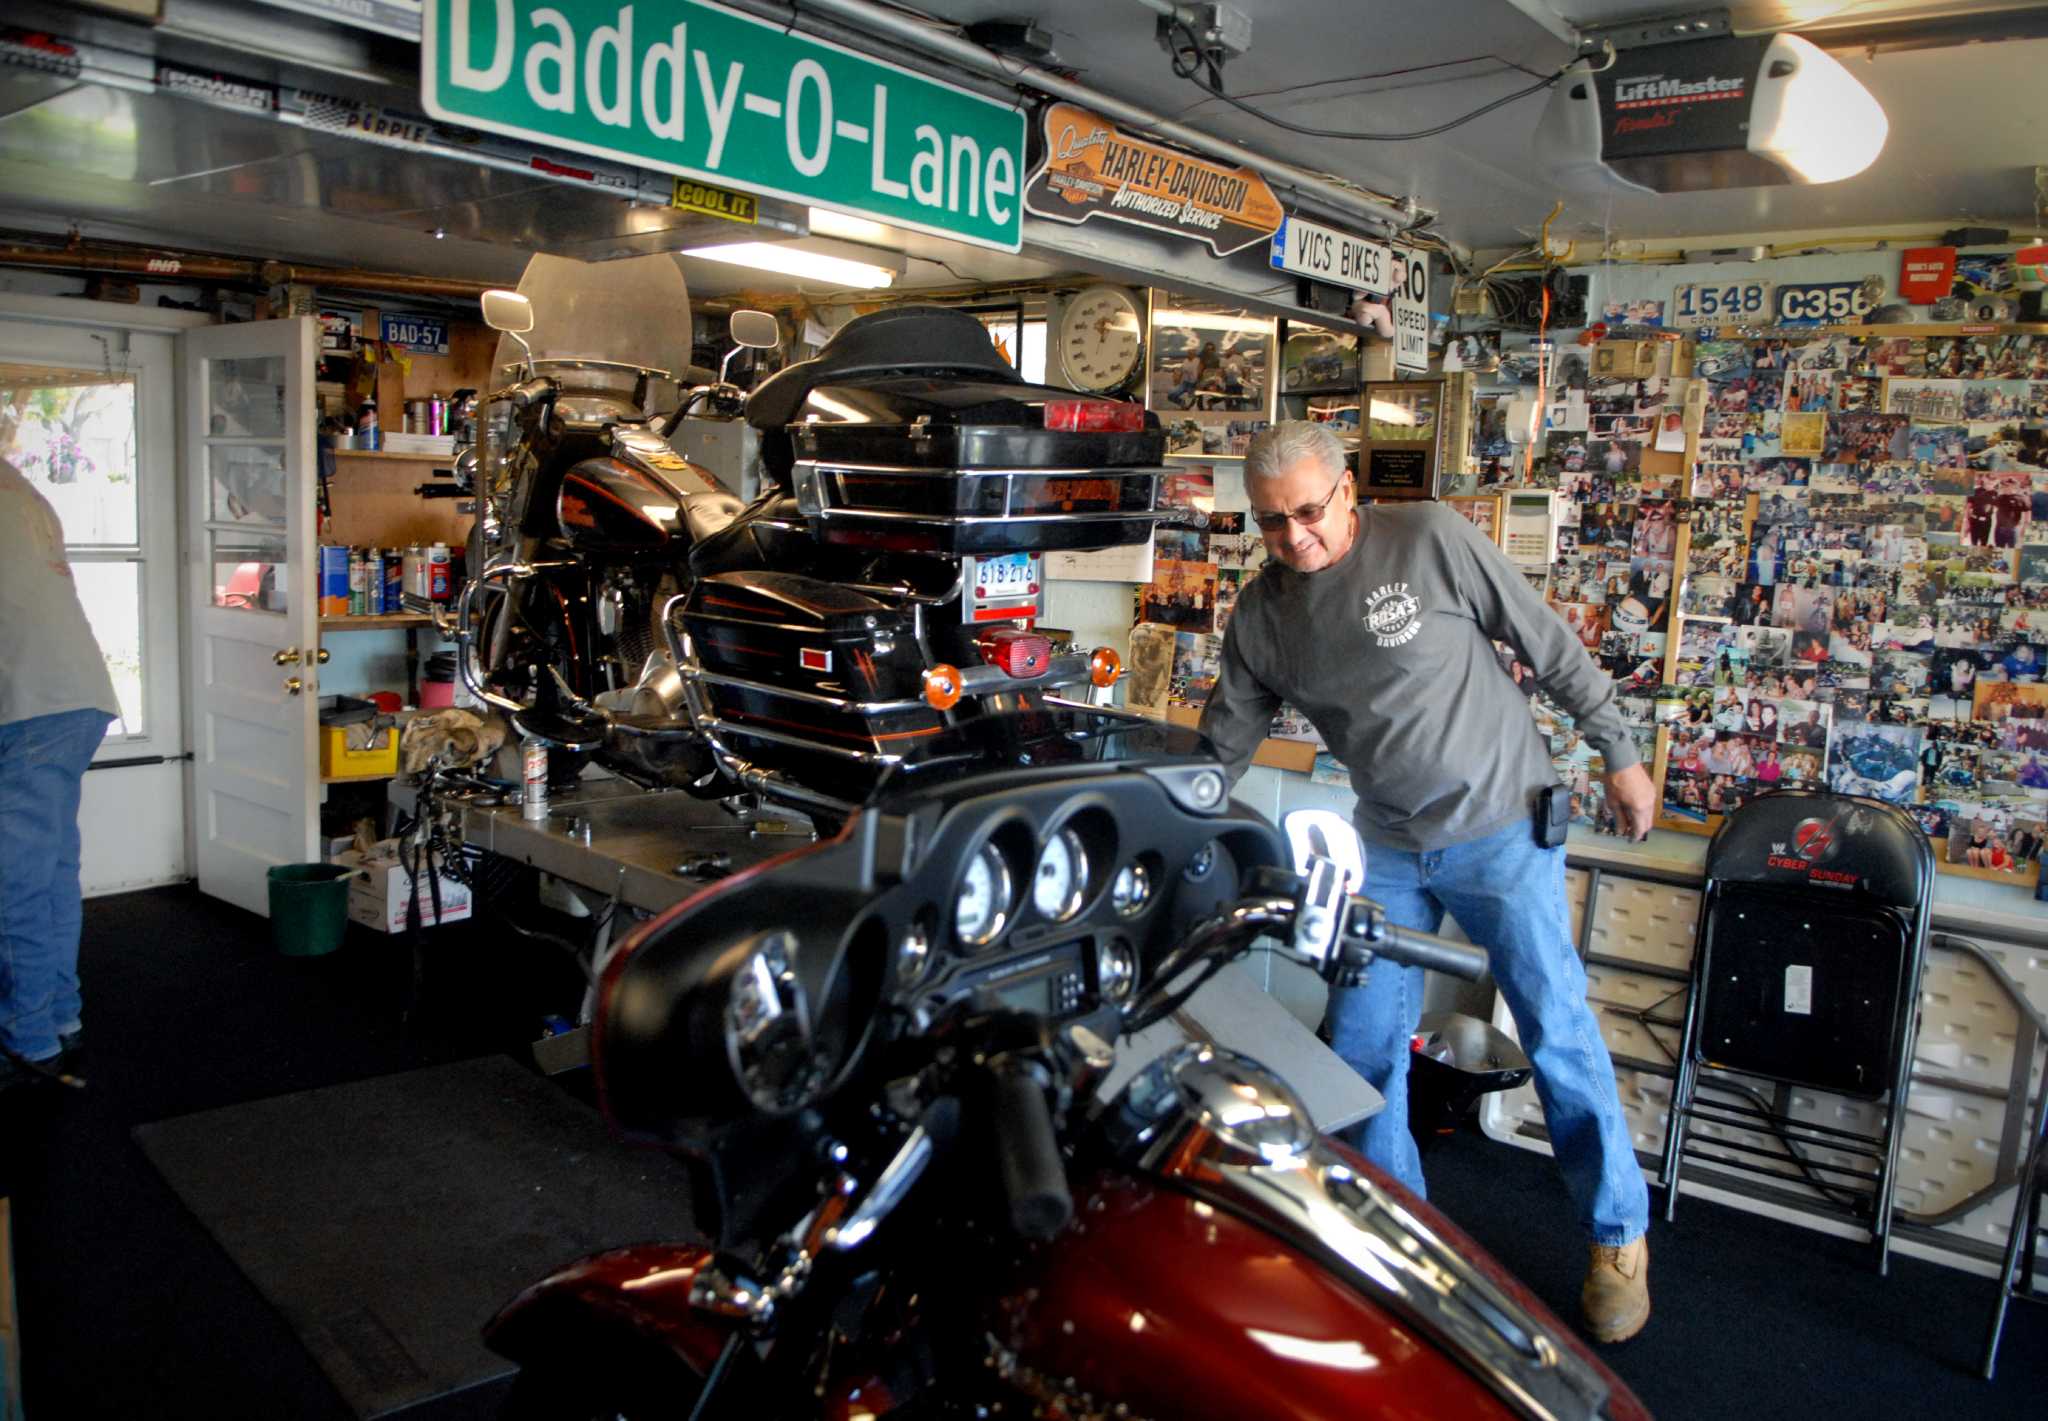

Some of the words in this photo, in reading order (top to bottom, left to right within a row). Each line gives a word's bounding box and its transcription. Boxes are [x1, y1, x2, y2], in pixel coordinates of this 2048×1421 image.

[168, 70, 266, 100] POWER
[1615, 75, 1744, 102] LiftMaster
[345, 112, 425, 143] PURPLE
[1100, 140, 1249, 213] HARLEY-DAVIDSON
[679, 183, 728, 211] COOL
[1110, 181, 1180, 220] AUTHORIZED
[1178, 200, 1224, 230] SERVICE
[1298, 228, 1333, 271] VICS
[1340, 241, 1380, 285] BIKES
[1679, 285, 1763, 316] 1548
[1397, 307, 1426, 332] SPEED
[1400, 336, 1424, 355] LIMIT
[1364, 582, 1408, 607] HARLEY
[1376, 621, 1422, 648] DAVIDSON
[1767, 855, 1809, 871] CYBER
[1808, 868, 1857, 885] SUNDAY
